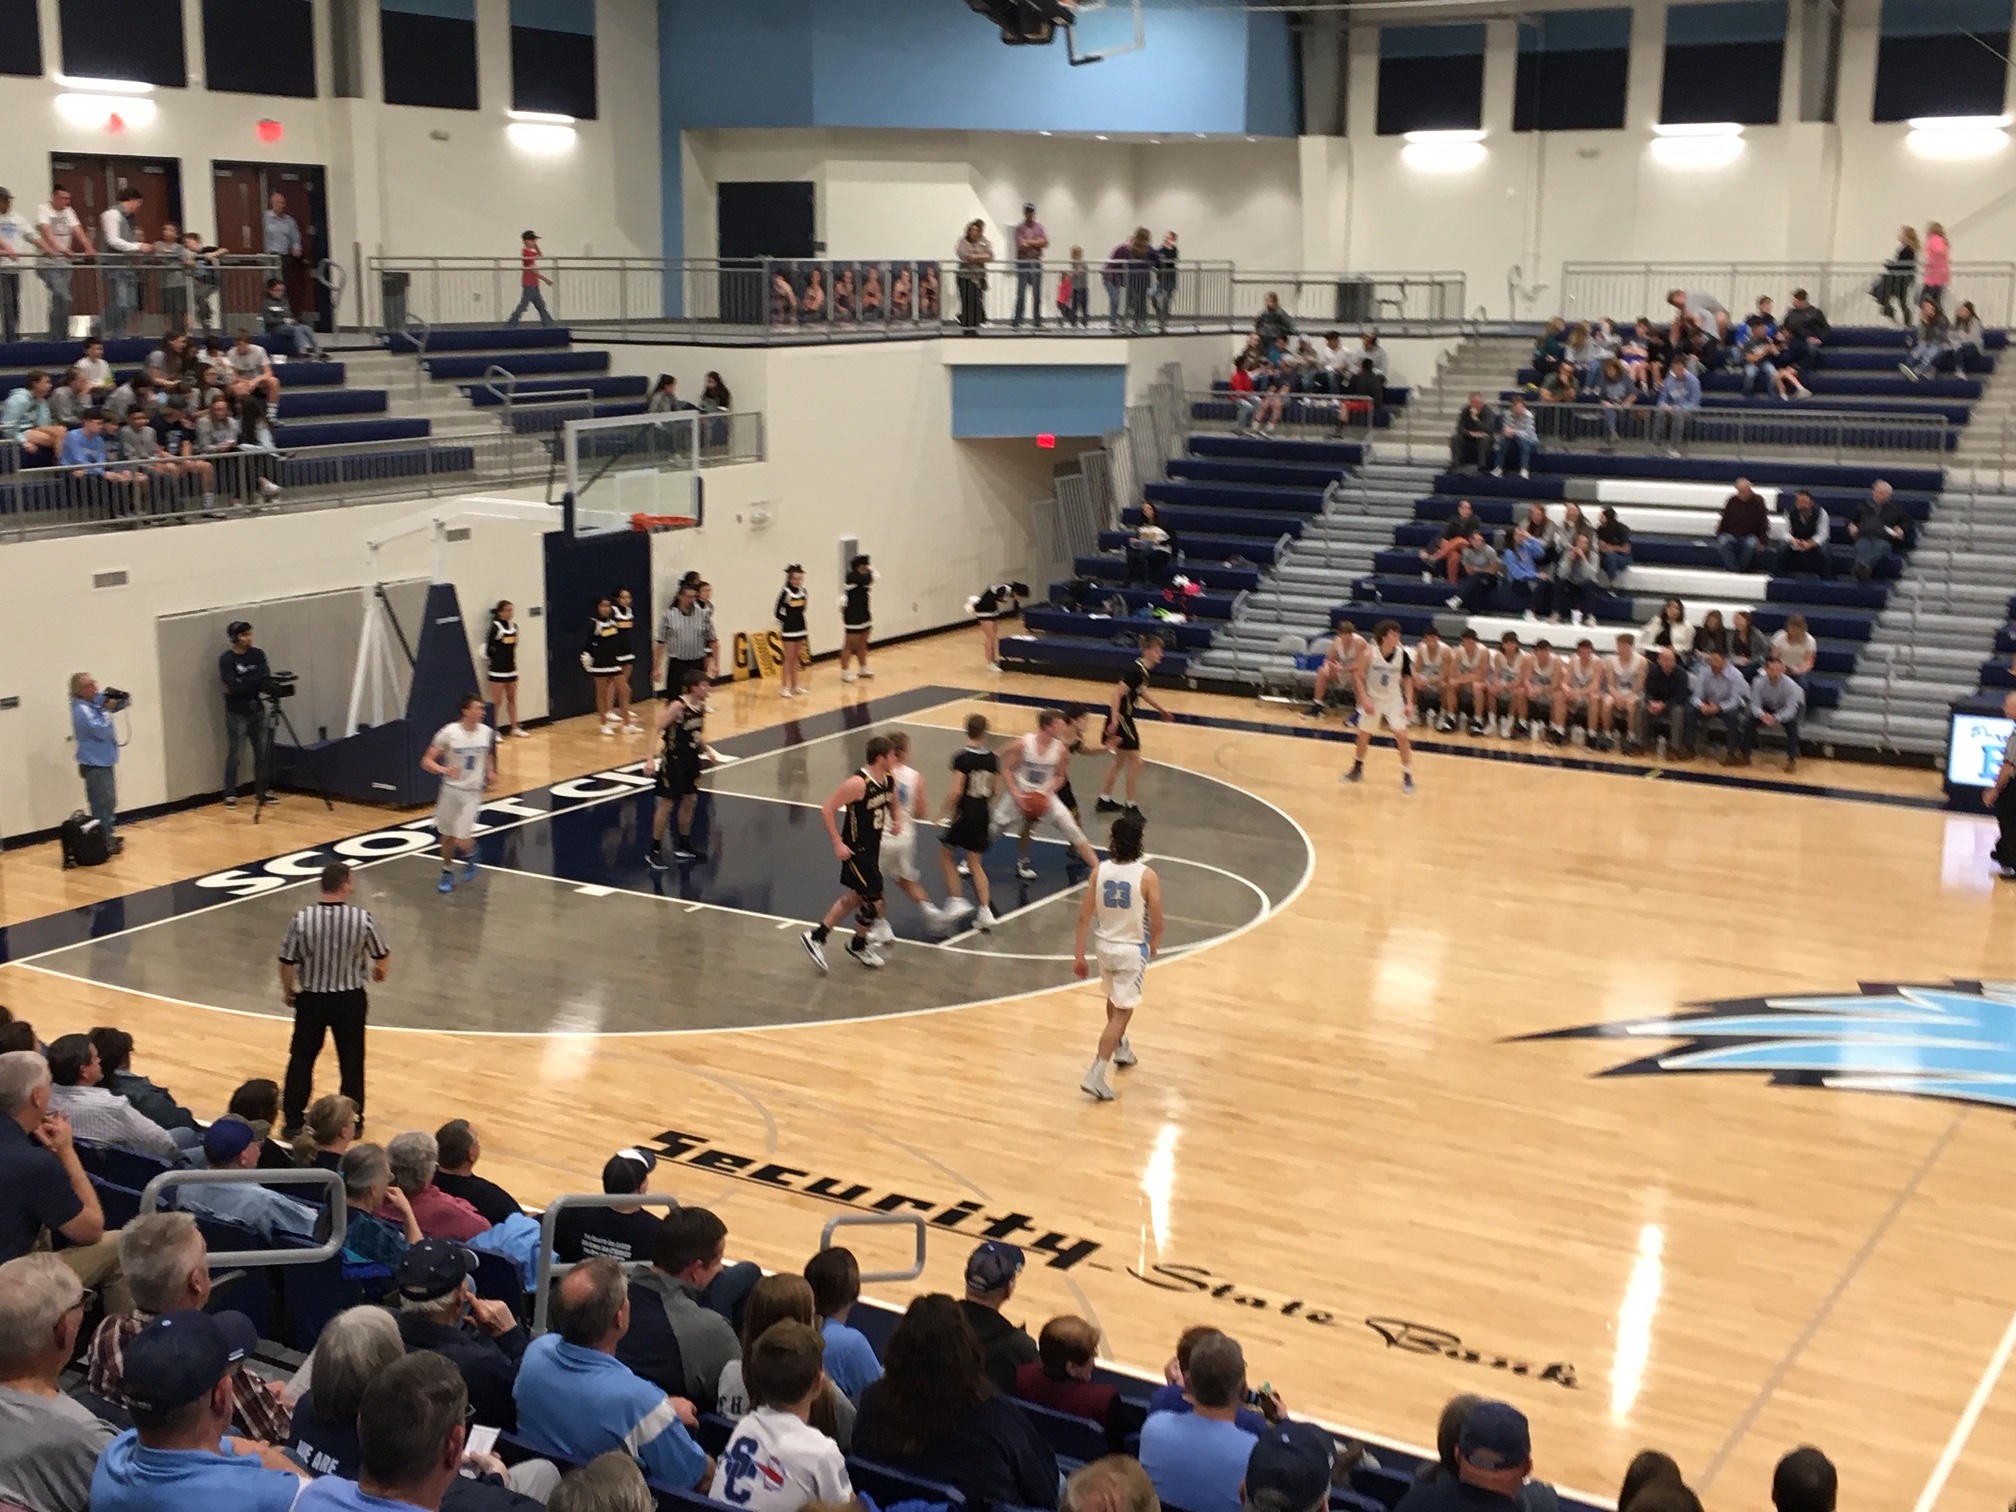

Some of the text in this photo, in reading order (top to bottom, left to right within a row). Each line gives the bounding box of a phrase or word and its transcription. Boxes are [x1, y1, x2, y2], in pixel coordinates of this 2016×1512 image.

[1103, 880, 1131, 909] 23
[636, 1130, 1103, 1270] Security
[1127, 1263, 1334, 1325] State
[311, 1451, 340, 1475] ARE
